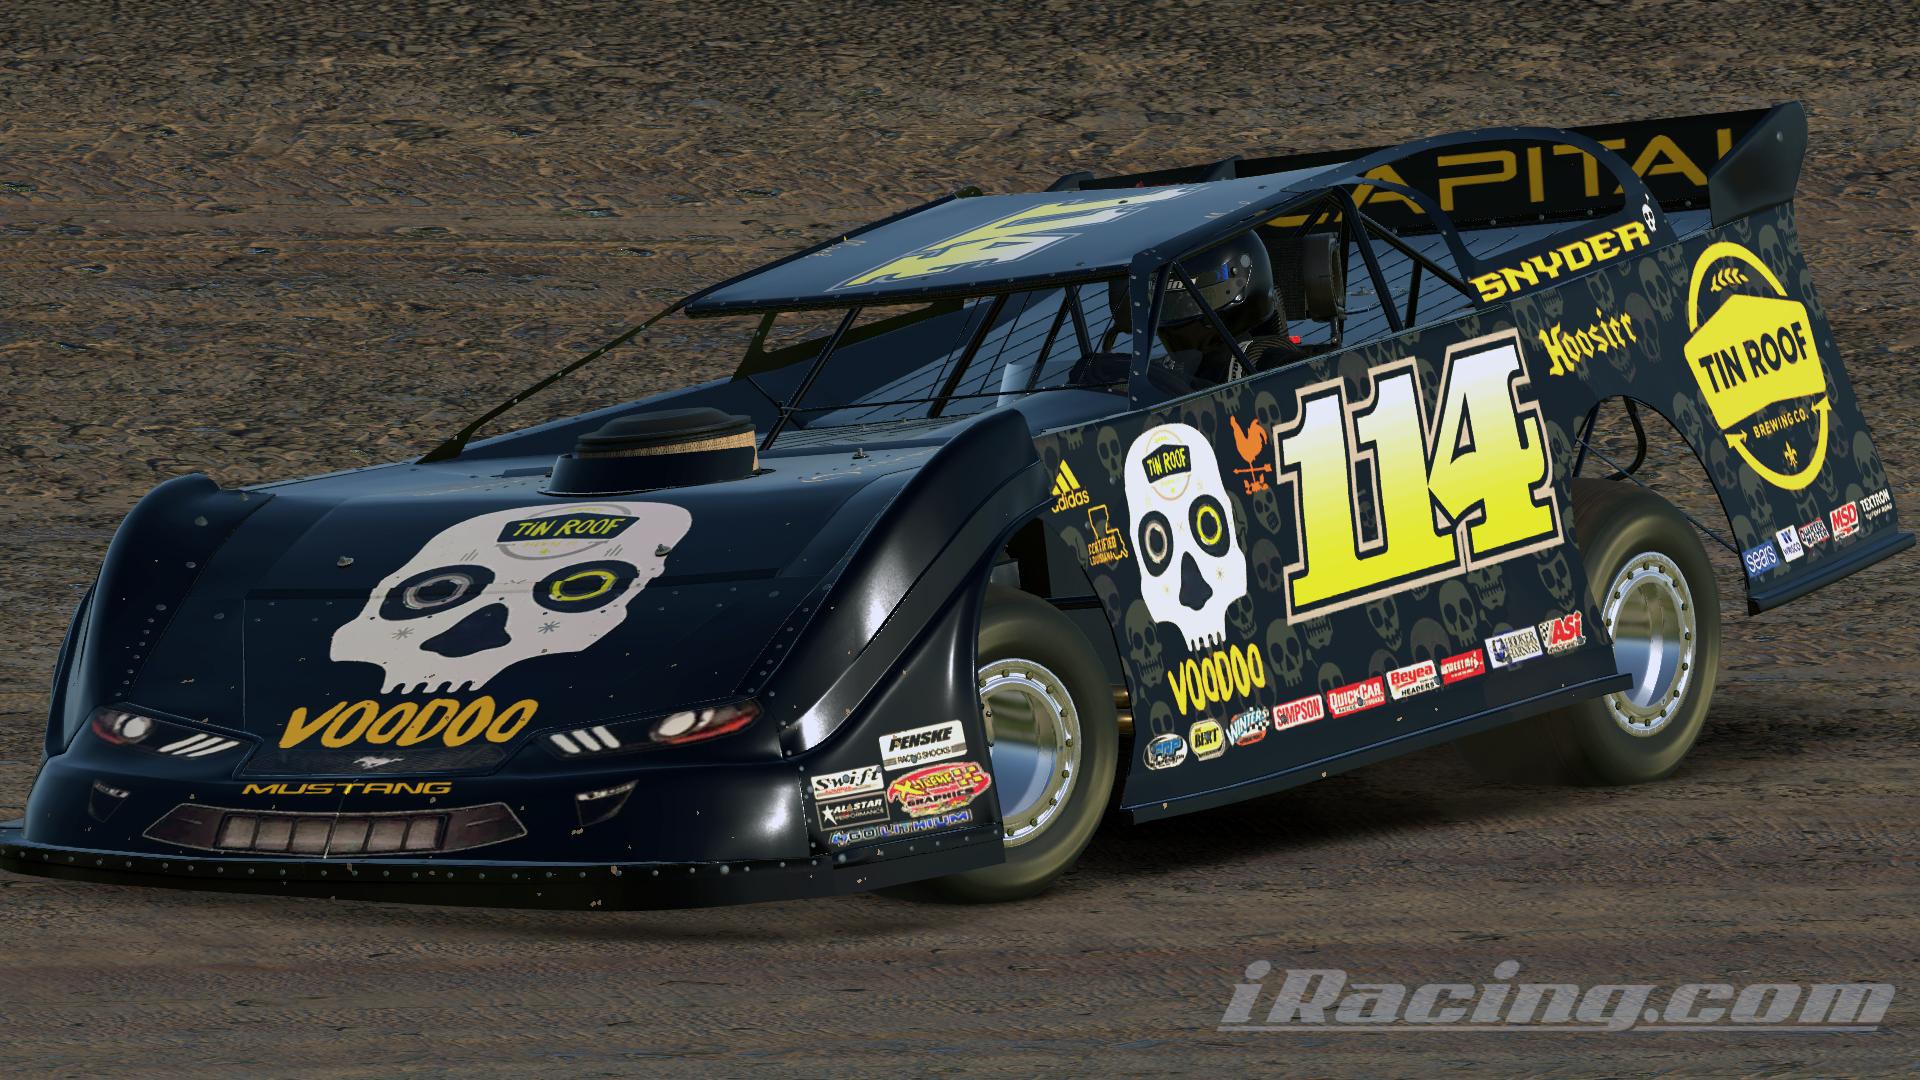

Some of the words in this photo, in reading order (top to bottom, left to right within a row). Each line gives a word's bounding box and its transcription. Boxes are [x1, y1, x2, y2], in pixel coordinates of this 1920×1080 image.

[1266, 127, 1732, 228] APITA
[1468, 221, 1651, 303] SNYDER
[1538, 307, 1638, 377] Hoosier
[1698, 346, 1747, 394] TIN
[1743, 321, 1808, 379] ROOF
[1752, 414, 1795, 439] BREWING
[1793, 407, 1810, 423] CO.
[1162, 447, 1186, 474] ROOF
[1273, 328, 1564, 625] 114
[1859, 488, 1891, 513] TEXTRON
[553, 518, 626, 537] ROOF
[1831, 503, 1858, 531] MSD
[1167, 643, 1266, 715] VOODOO
[1391, 664, 1433, 688] Beyea
[1401, 681, 1435, 697] HEADERS
[278, 696, 539, 749] VOODOO
[1225, 706, 1269, 746] WINTERS
[1276, 697, 1321, 728] SIMPSON
[888, 726, 953, 753] PENSKE
[242, 782, 453, 795] MUSTANG
[815, 767, 881, 792] Swift
